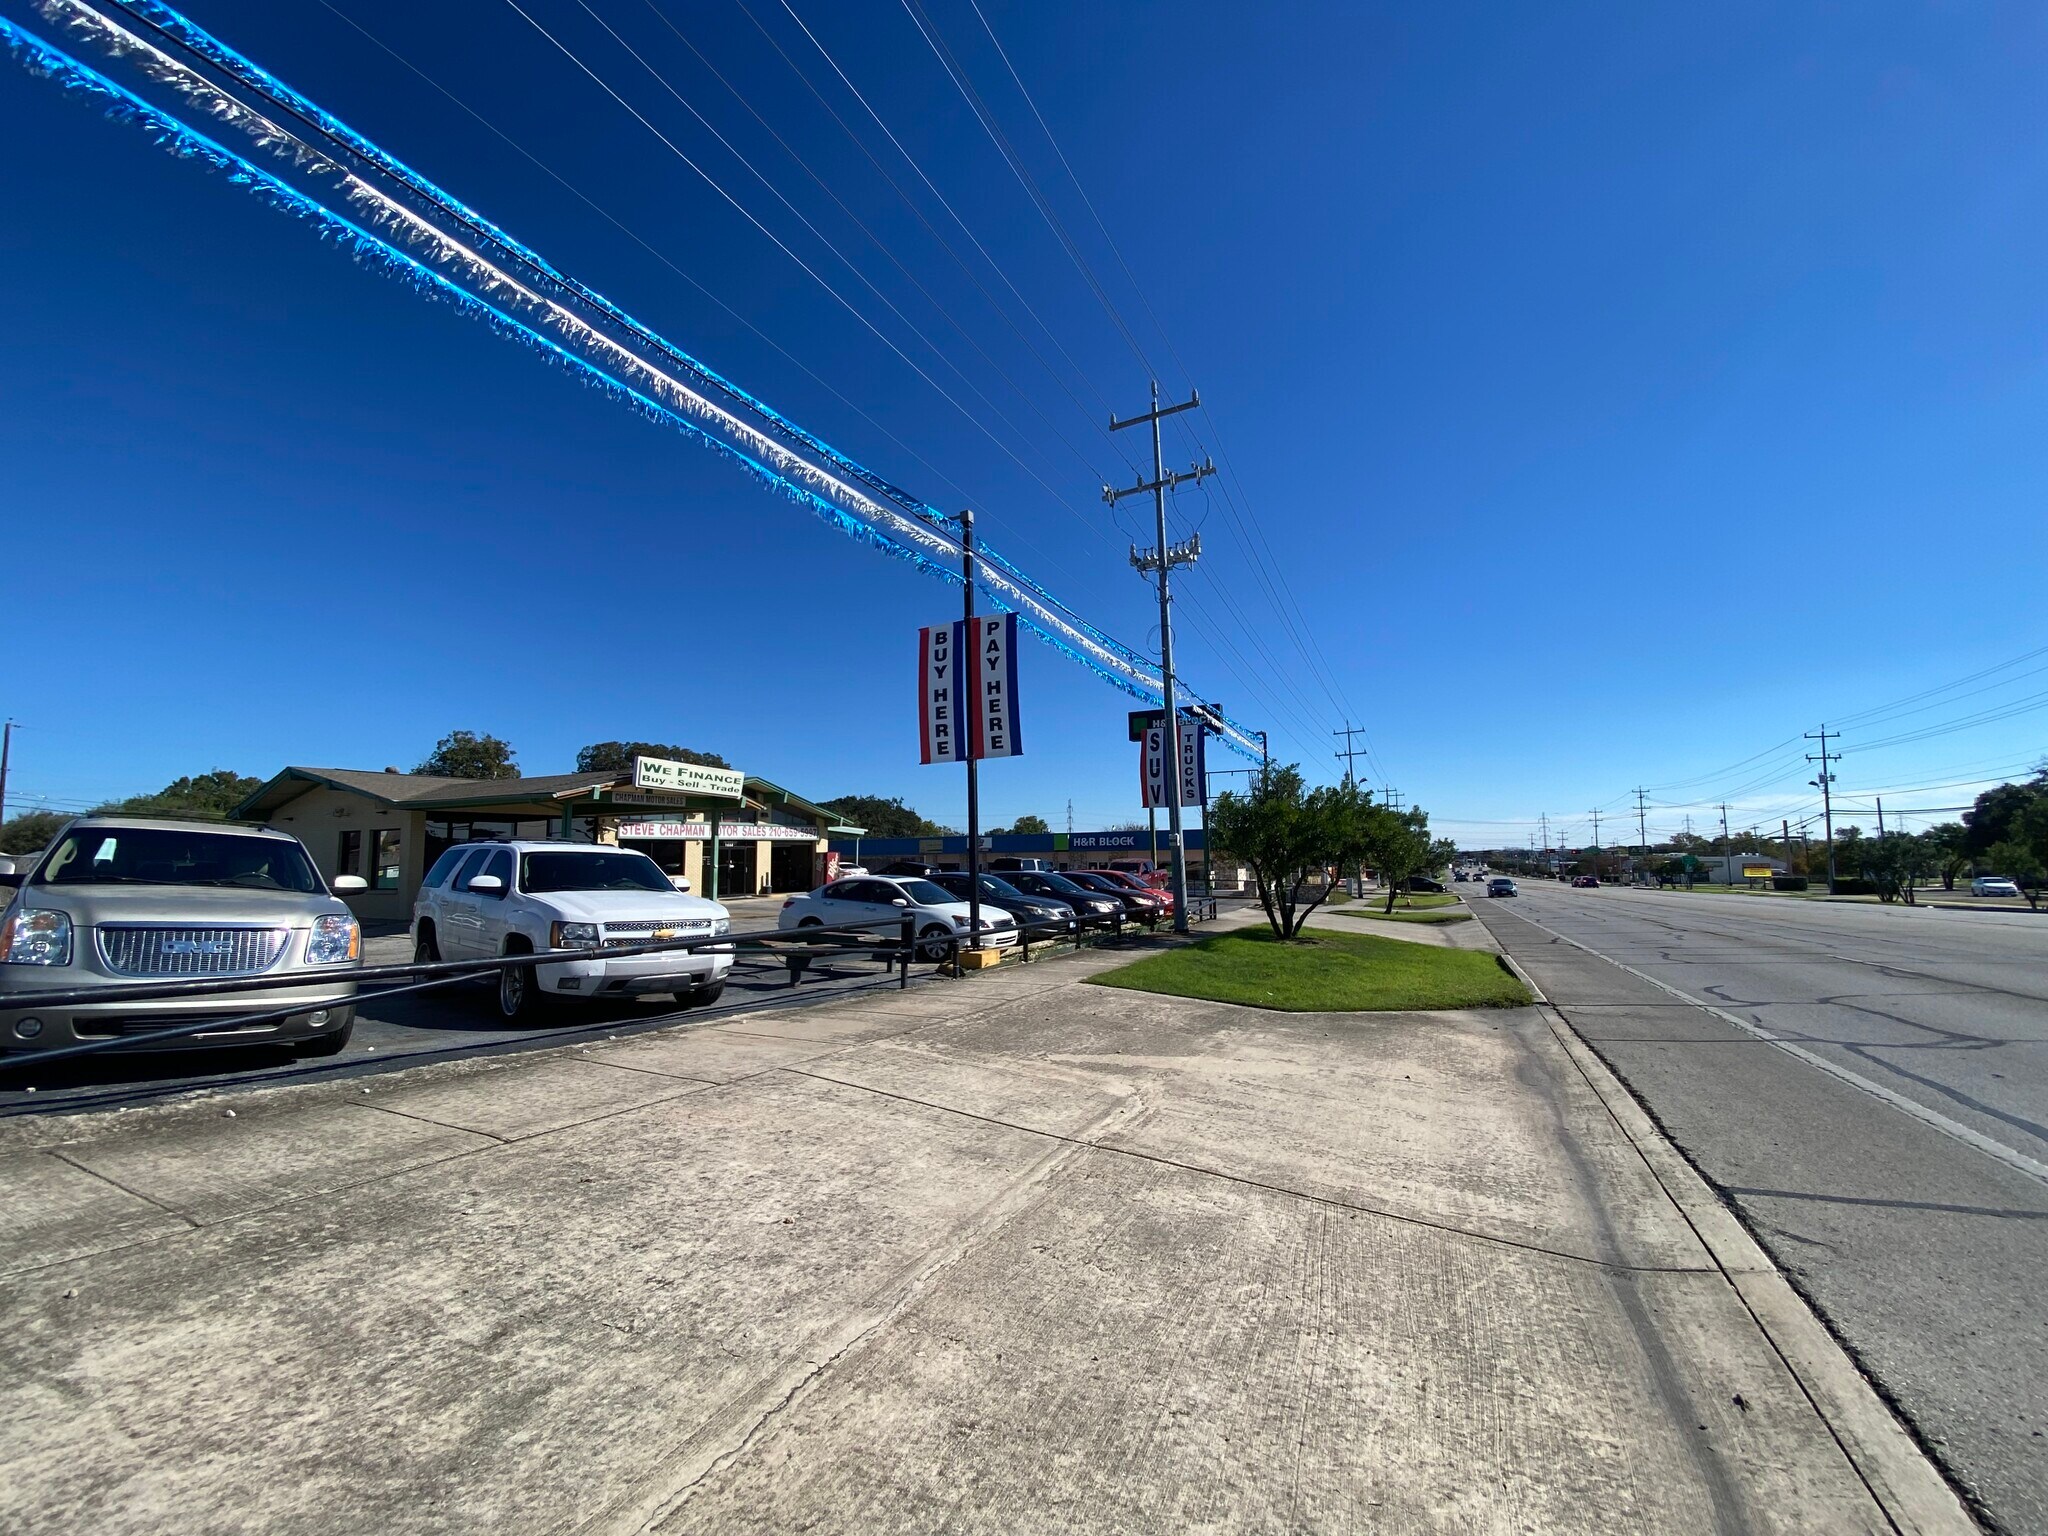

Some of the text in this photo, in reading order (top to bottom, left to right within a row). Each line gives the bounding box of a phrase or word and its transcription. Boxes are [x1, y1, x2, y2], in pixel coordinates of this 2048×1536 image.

[934, 631, 950, 755] BUY HERE
[986, 621, 1004, 750] PAY HERE
[677, 766, 742, 785] FINANCE
[1149, 732, 1161, 804] SUV
[1184, 733, 1195, 799] TRUCKS
[642, 774, 666, 786] Buy
[677, 779, 699, 789] Sell
[709, 783, 740, 794] Trade
[615, 793, 684, 805] CHAPMAN MOTOR SALES
[621, 823, 817, 838] STEVE CHAPMAN OTOR SALES 210-659-5997
[1073, 836, 1135, 847] H&R BLOCK
[161, 940, 233, 954] GMC
